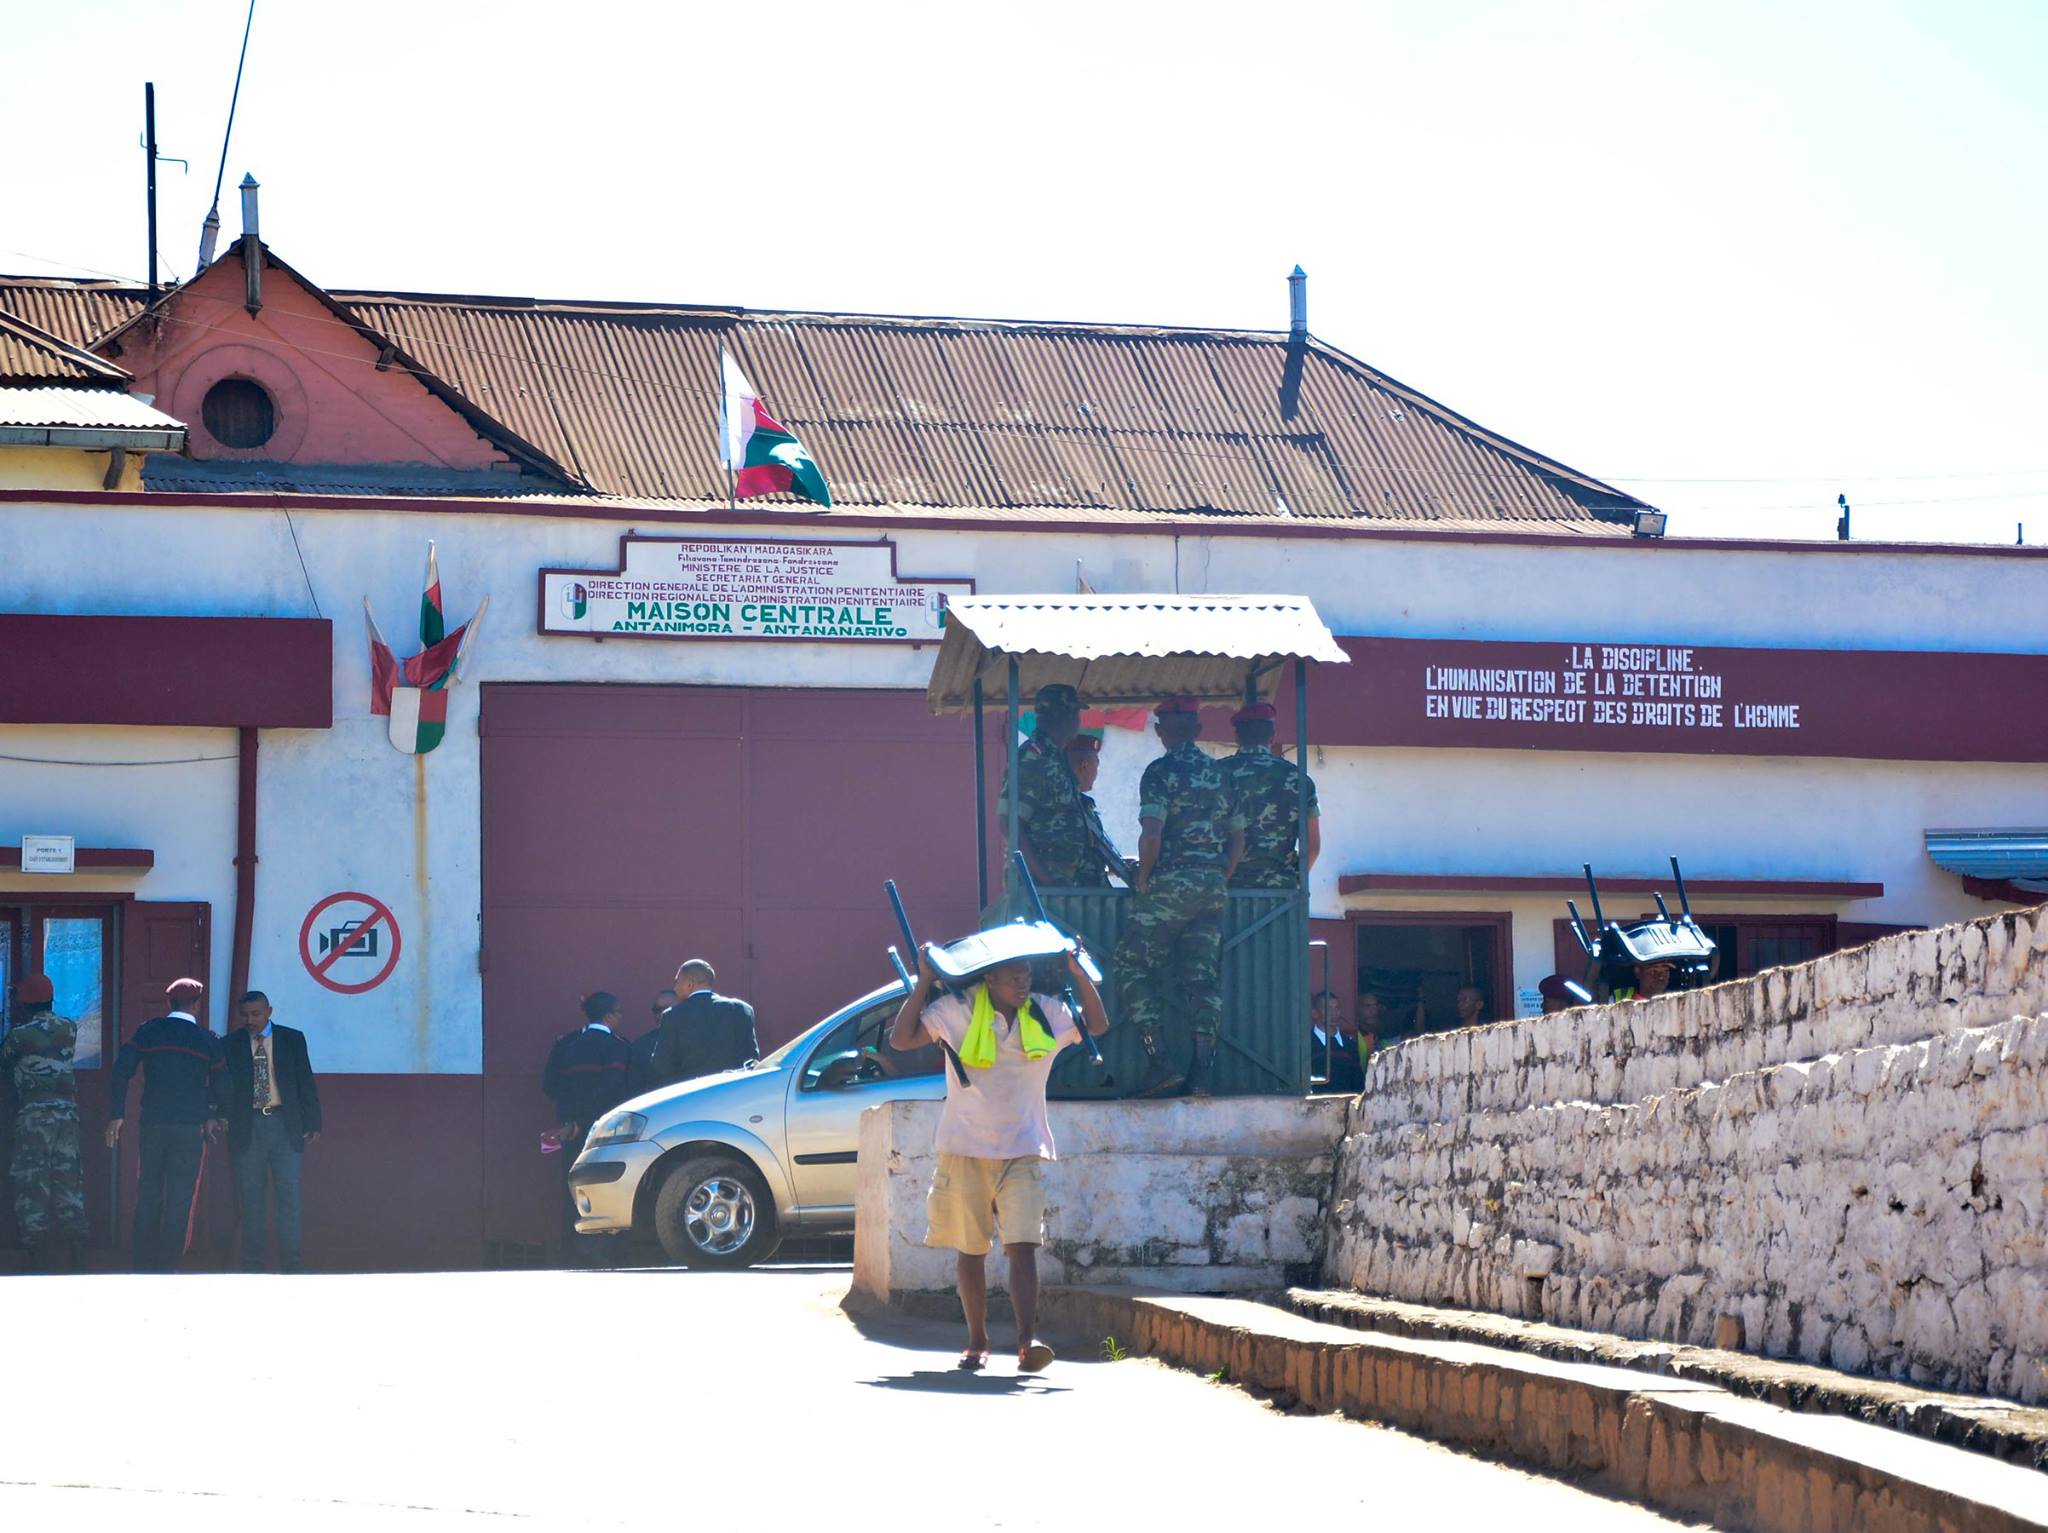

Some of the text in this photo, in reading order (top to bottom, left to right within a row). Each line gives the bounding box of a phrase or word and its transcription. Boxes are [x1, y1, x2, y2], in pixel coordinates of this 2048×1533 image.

[755, 545, 833, 555] MADAGASIKARA
[682, 563, 833, 575] MINISTERE DE LA JUSTICE
[696, 573, 820, 585] SECRETARIAT GENERAL
[588, 581, 925, 597] DIRECTION GENERALE DE L'ADMINISTRATION PENITENTIAIRE
[588, 590, 650, 601] DIRECTION
[652, 592, 717, 602] REGIONALE
[718, 593, 735, 603] DE
[838, 596, 925, 607] PENITENTIAIRE
[627, 601, 893, 625] MAISON CENTRALE
[612, 621, 733, 633] ANTANIMORA
[762, 624, 908, 637] ANTANANARIVO
[1572, 646, 1694, 672] LA DISCIPLINE
[1426, 664, 1722, 698] L'HUMANISATION DE LA DETENTION
[1426, 695, 1800, 728] EN VUE DU RESPECT DES DROITS DE L'HOMME
